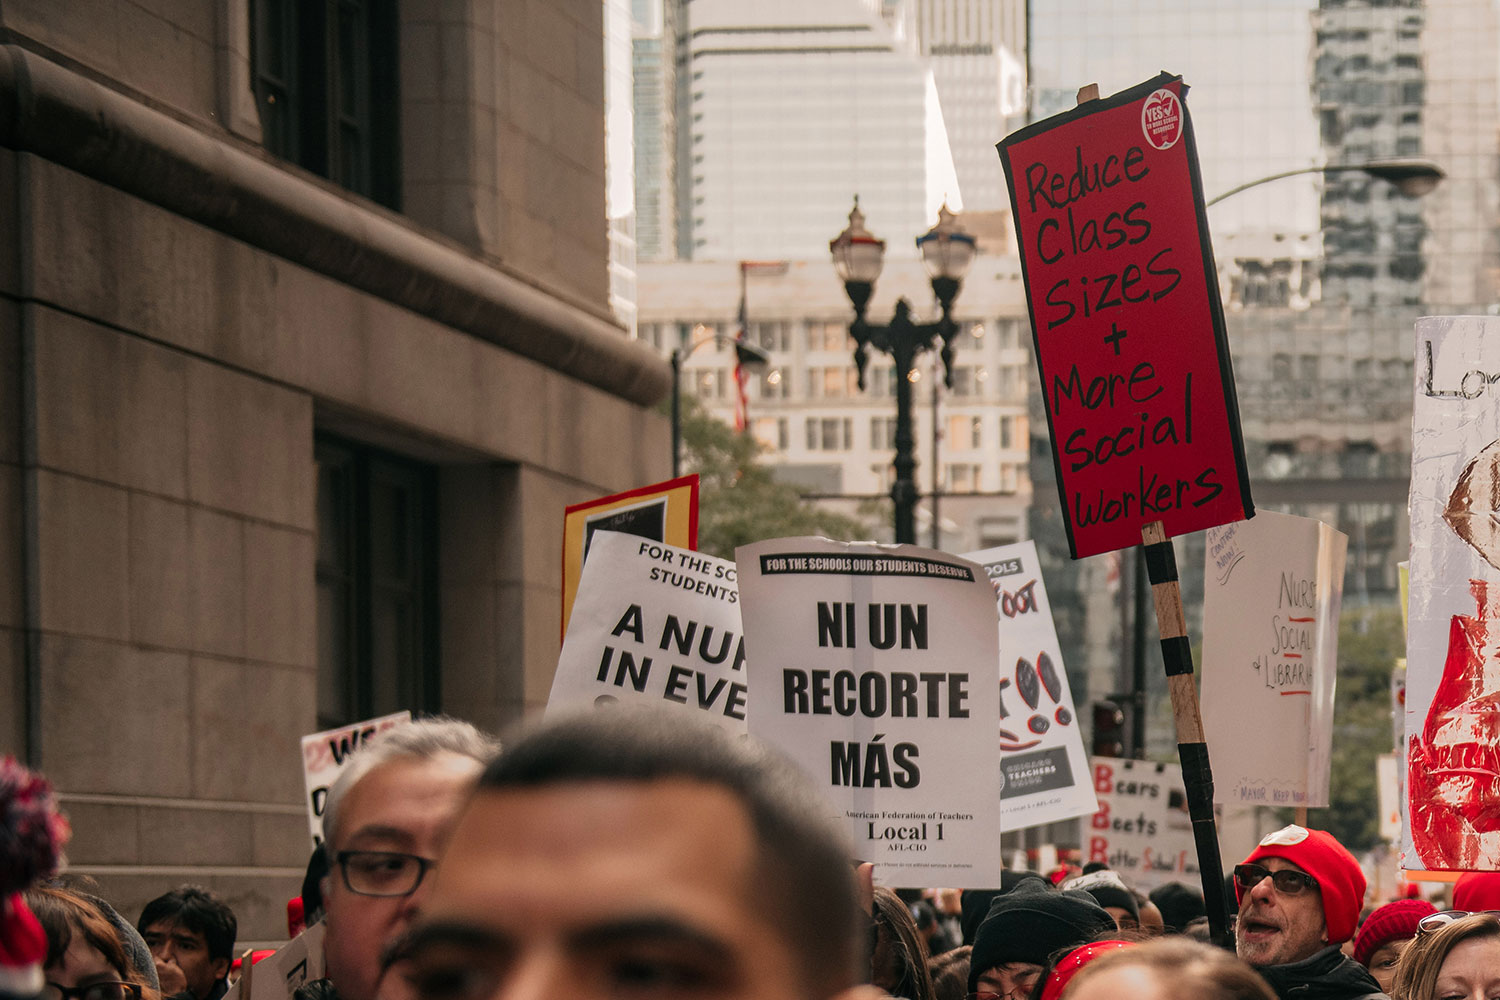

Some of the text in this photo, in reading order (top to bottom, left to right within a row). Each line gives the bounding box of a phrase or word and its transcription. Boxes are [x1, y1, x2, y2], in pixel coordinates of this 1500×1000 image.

[1146, 104, 1163, 122] YES
[1025, 146, 1150, 213] Reduce
[1037, 202, 1152, 264] Class
[1053, 362, 1163, 415] More
[1064, 372, 1193, 472] Social
[638, 542, 673, 564] FOR
[679, 553, 711, 575] THE
[766, 557, 969, 578] FOR THE SCHOOLS OUR STUDENTS DESERVE
[649, 566, 739, 604] STUDENTS
[611, 603, 644, 644] A
[817, 601, 929, 650] NI UN
[596, 645, 653, 693] IN
[782, 668, 970, 719] RECORTE
[830, 733, 921, 788] MÁS
[1008, 765, 1057, 780] TEACHERS
[1093, 763, 1160, 798] Bears
[846, 810, 974, 820] American Federation of Teachers
[867, 822, 945, 840] Local 1
[1091, 800, 1158, 834] Beets
[887, 843, 928, 852] AFL-CIO
